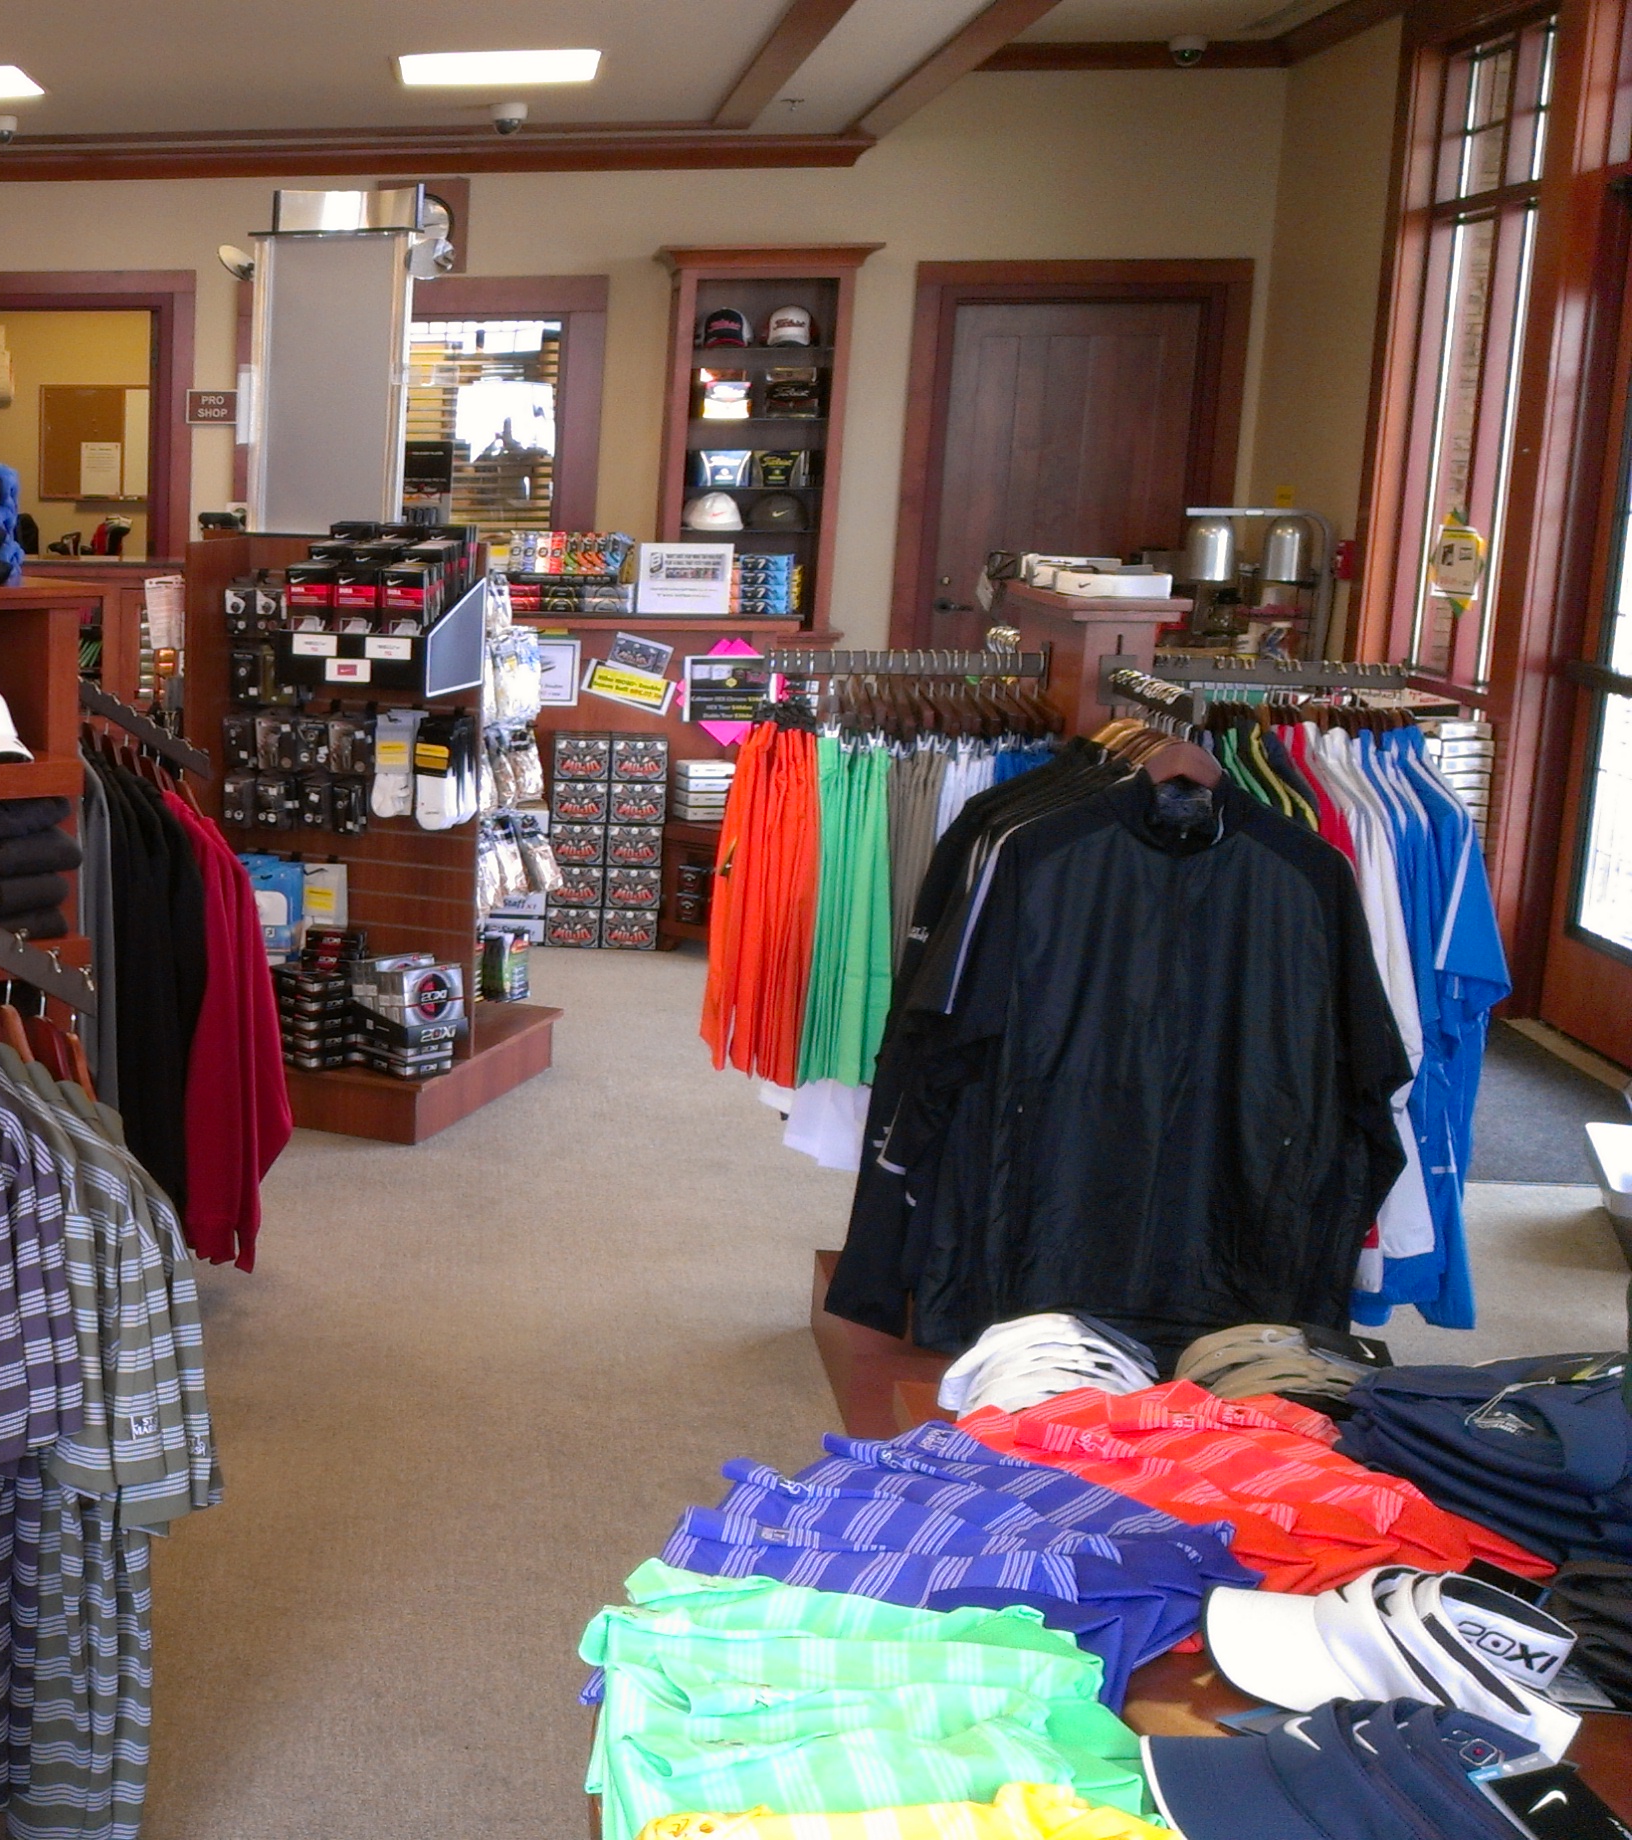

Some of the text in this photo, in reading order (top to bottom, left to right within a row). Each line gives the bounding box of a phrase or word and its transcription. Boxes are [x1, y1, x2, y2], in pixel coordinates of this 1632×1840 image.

[201, 395, 225, 405] PRO
[197, 408, 228, 418] SHOP
[561, 759, 601, 772] MOJO
[619, 760, 660, 773] MOJO
[559, 802, 600, 815] MOJO
[618, 804, 658, 816] MOJO
[557, 844, 596, 858] MOJO
[615, 846, 655, 859] MOJO
[613, 888, 653, 900] MOJO
[552, 927, 591, 939] MOJO
[610, 929, 649, 941] MOJO
[421, 989, 448, 1001] 20XI
[420, 1026, 457, 1042] 20XI
